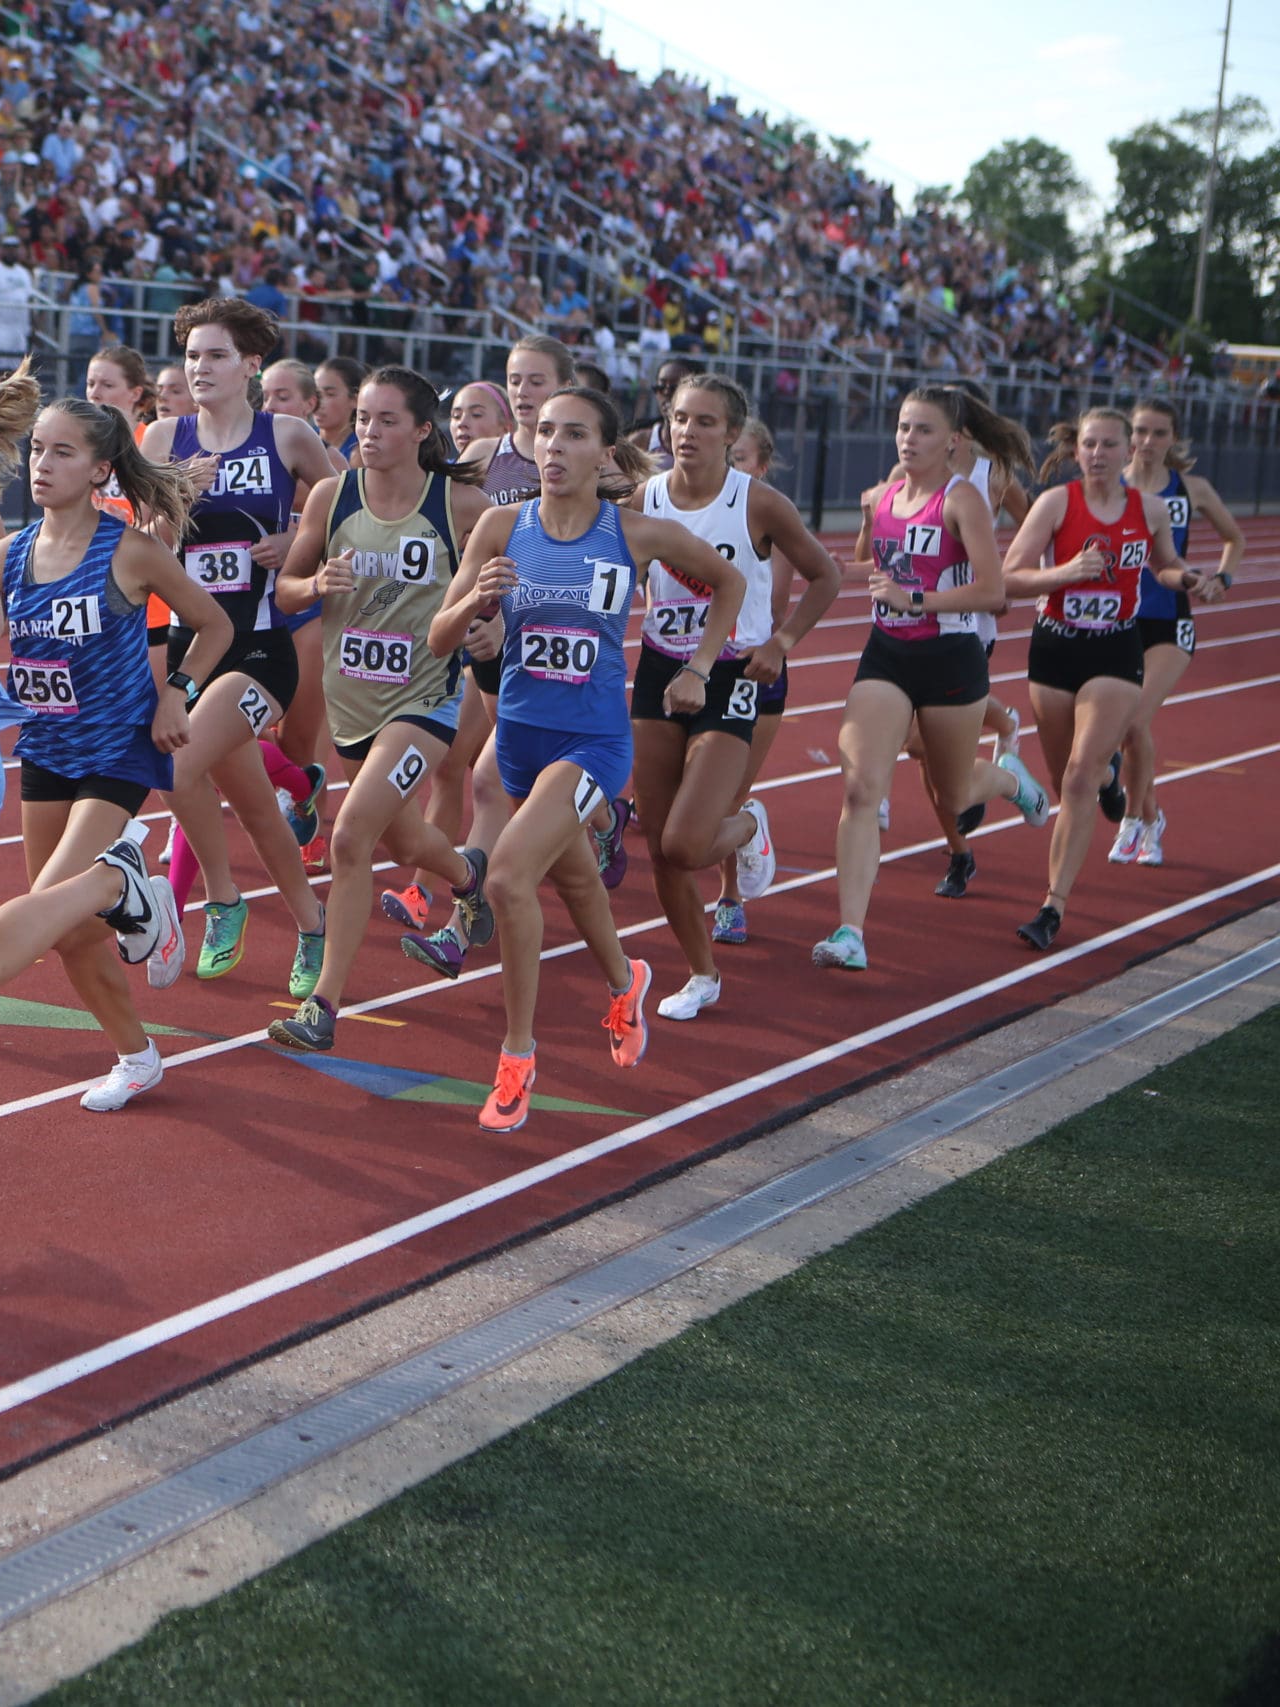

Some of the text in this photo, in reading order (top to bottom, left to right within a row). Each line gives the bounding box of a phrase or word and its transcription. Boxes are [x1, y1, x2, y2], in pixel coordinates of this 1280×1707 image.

[227, 458, 264, 489] 24
[907, 526, 936, 553] 17
[1122, 544, 1145, 567] 25
[198, 551, 239, 583] 38
[402, 540, 429, 580] 9
[600, 567, 618, 611] 1
[55, 598, 90, 636] 21
[1066, 597, 1119, 620] 342
[1180, 622, 1193, 646] 8
[342, 637, 408, 673] 508
[525, 634, 596, 672] 280
[15, 667, 72, 703] 256
[733, 682, 754, 715] 3
[239, 687, 269, 729] 24
[395, 753, 423, 791] 9
